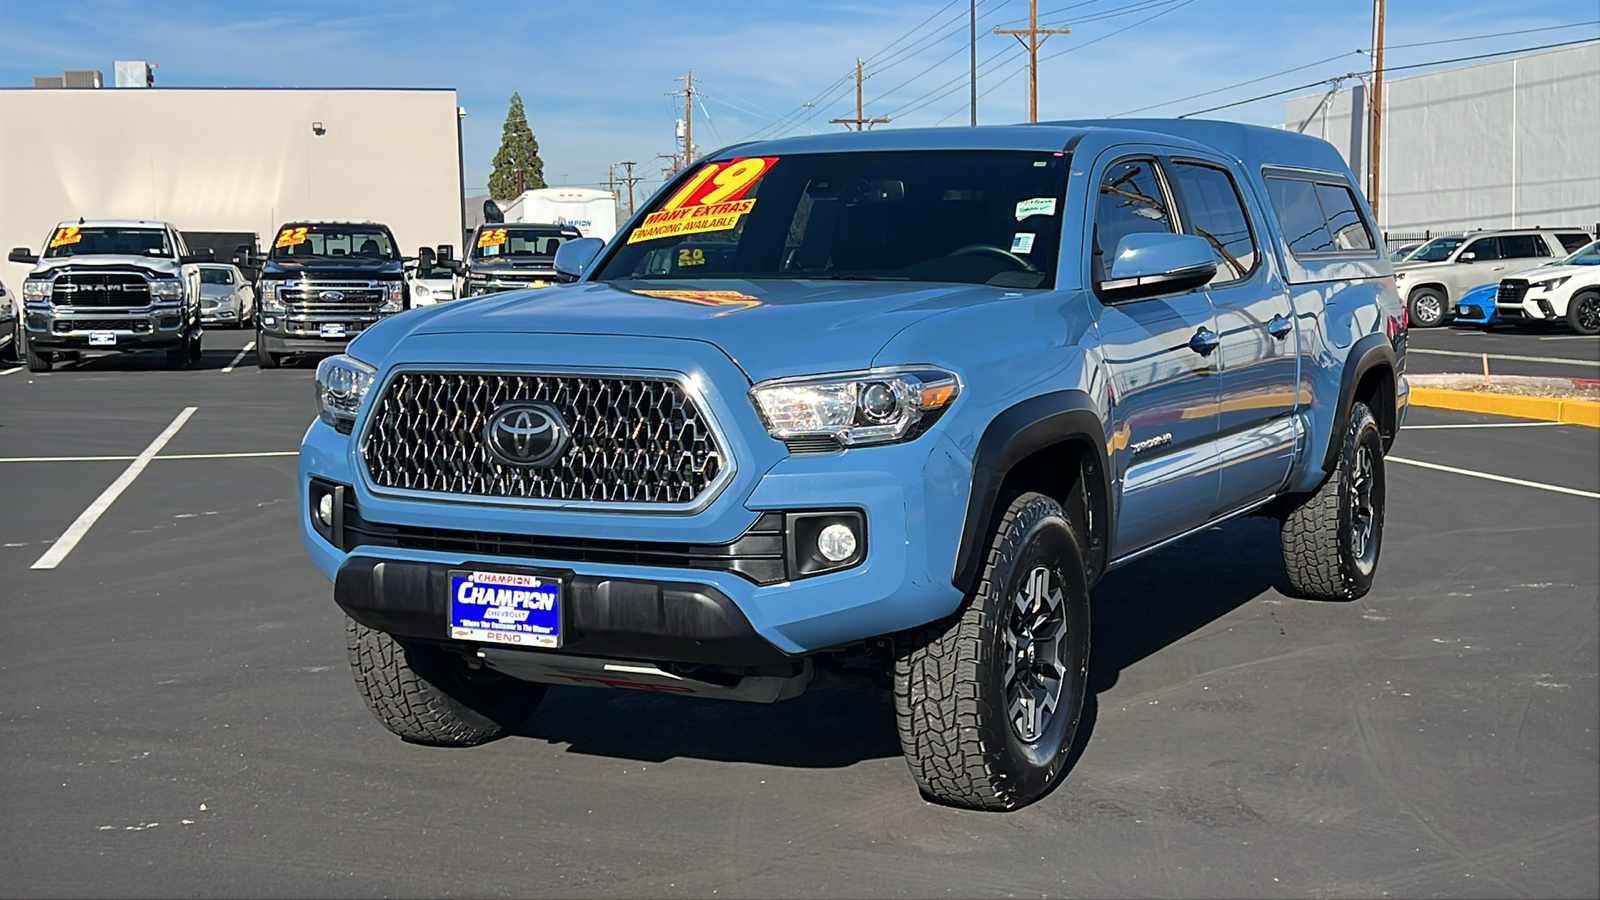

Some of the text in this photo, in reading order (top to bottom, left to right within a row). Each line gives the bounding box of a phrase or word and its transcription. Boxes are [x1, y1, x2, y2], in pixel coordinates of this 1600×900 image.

[664, 158, 766, 210] 19
[645, 201, 752, 224] MANY EXTRAS
[280, 227, 308, 241] 22
[480, 228, 507, 240] 25
[631, 216, 736, 239] FINANCING AVAILABLE
[679, 249, 703, 260] 20
[478, 574, 531, 585] CHAMPION
[457, 581, 555, 610] CHAMPION
[487, 609, 526, 619] CHEVROLET
[487, 632, 521, 643] RENO
